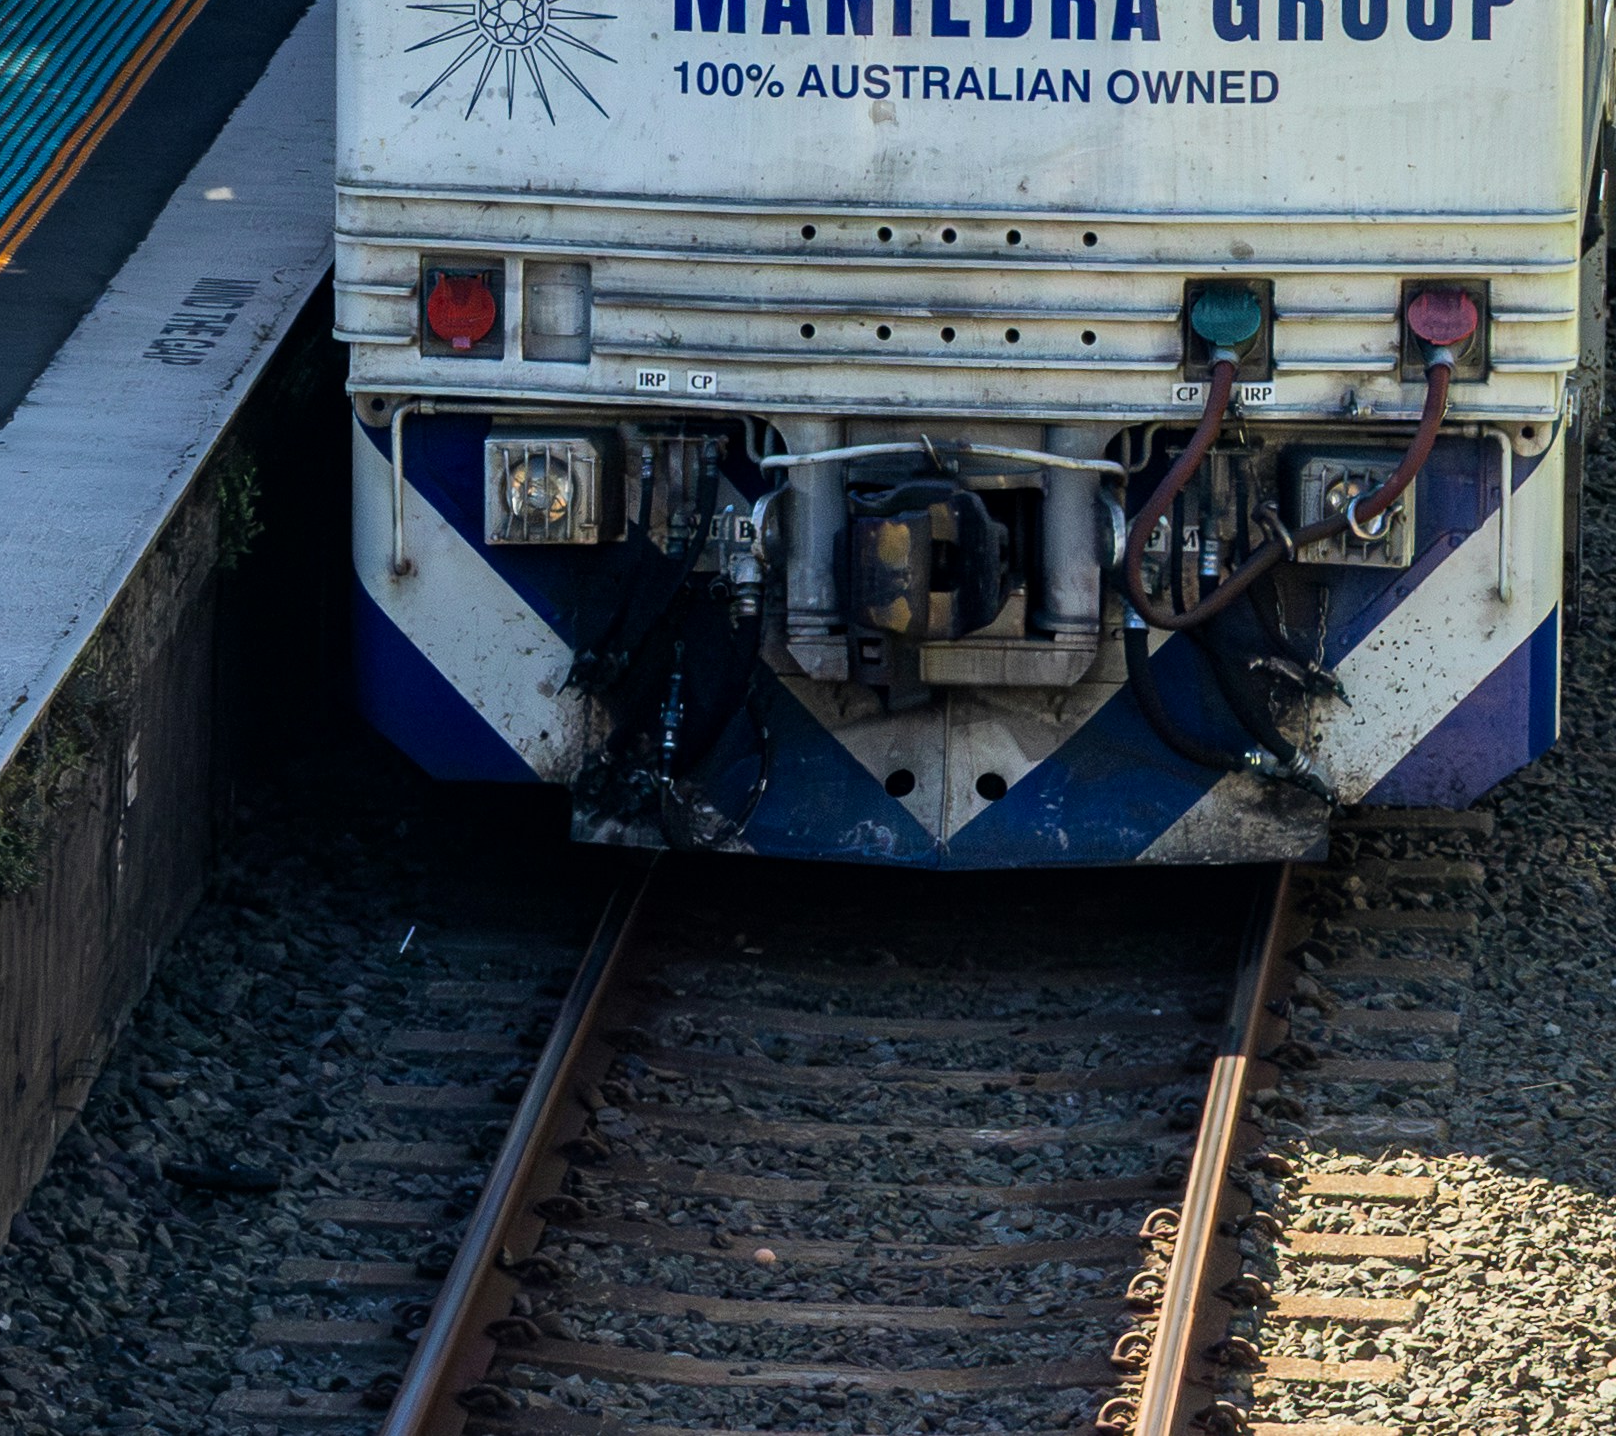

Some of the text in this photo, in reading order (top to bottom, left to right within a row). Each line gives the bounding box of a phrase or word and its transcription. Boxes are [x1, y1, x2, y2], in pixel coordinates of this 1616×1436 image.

[672, 59, 1280, 105] 100% AUSTRALIAN OWNED
[142, 277, 261, 366] MIND THE GAP
[638, 371, 666, 387] IRP
[690, 375, 713, 390] CP
[1175, 386, 1199, 402] CP
[1244, 386, 1272, 402] IRP
